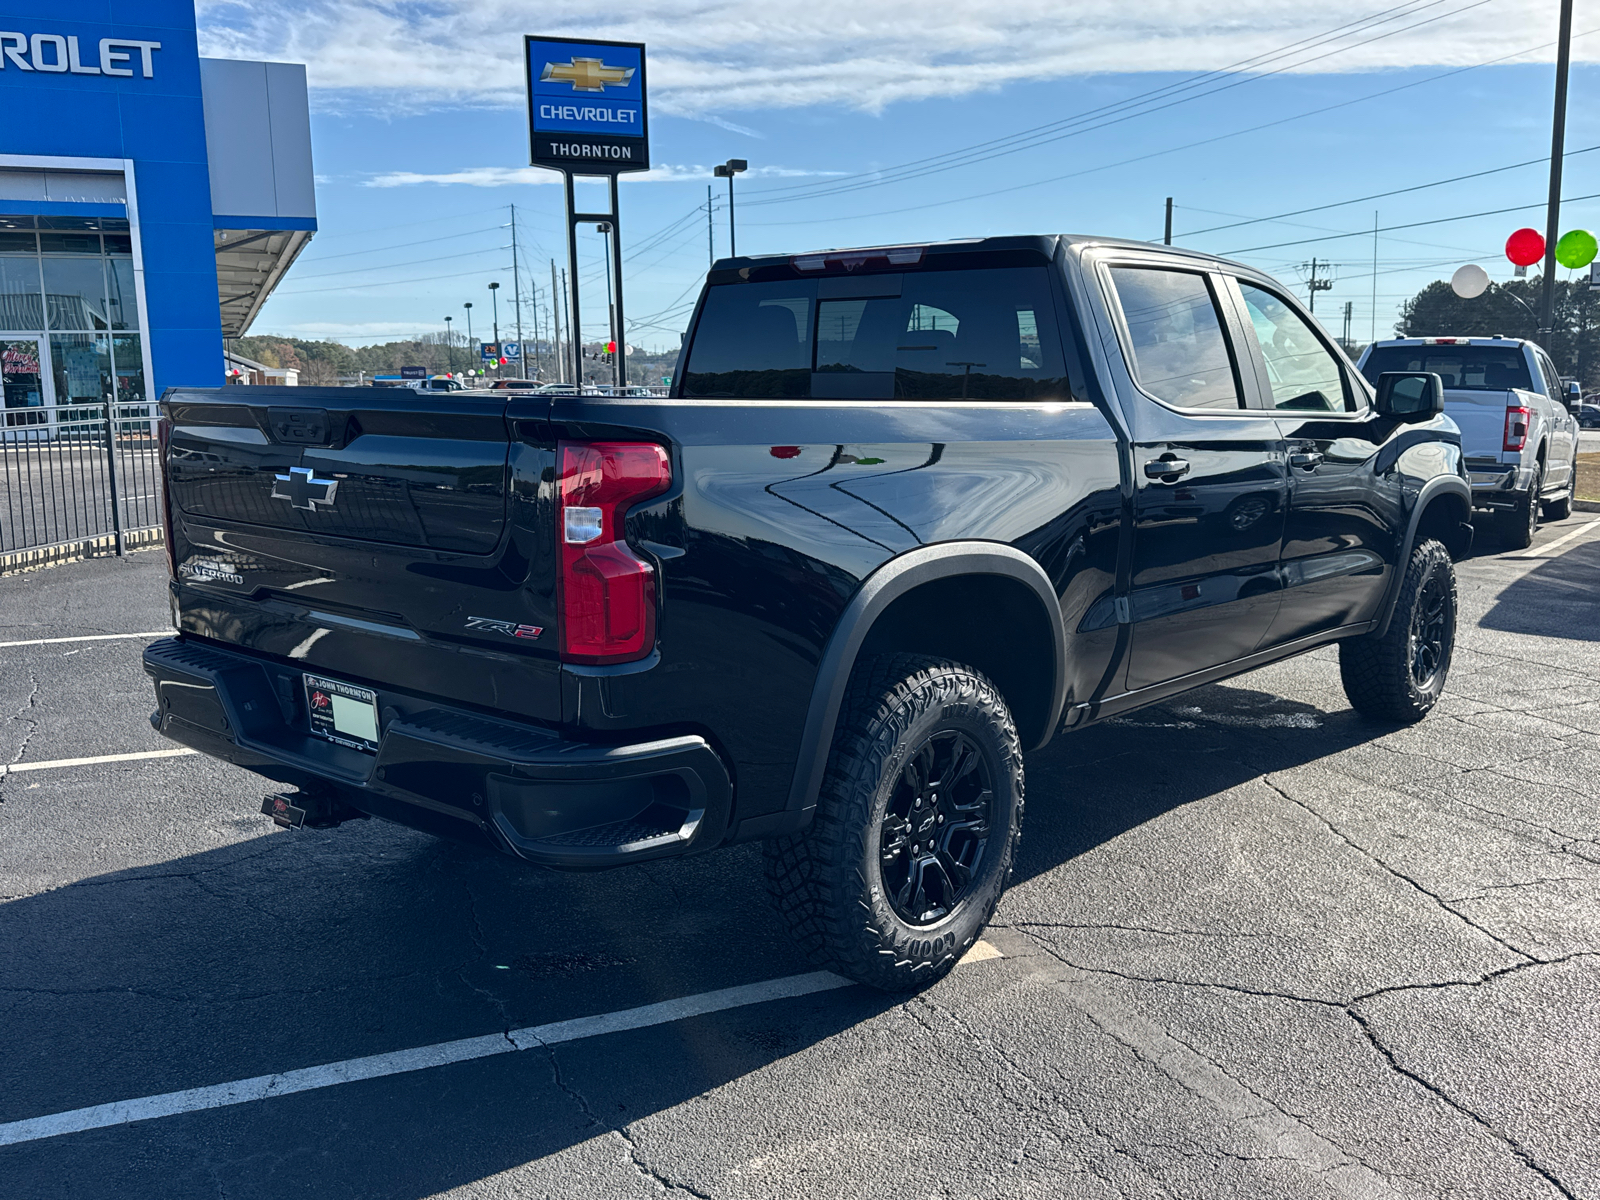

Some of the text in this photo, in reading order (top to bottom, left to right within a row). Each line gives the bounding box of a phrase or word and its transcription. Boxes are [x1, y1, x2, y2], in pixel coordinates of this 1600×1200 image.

[0, 31, 161, 78] ROLET
[540, 104, 637, 123] CHEVROLET
[550, 142, 631, 159] THORNTON
[1, 350, 33, 365] Merry
[180, 562, 244, 585] SILVERADO
[464, 616, 544, 640] ZR2
[319, 680, 372, 700] JOHN THORNTON
[335, 738, 357, 748] CHEVROLET
